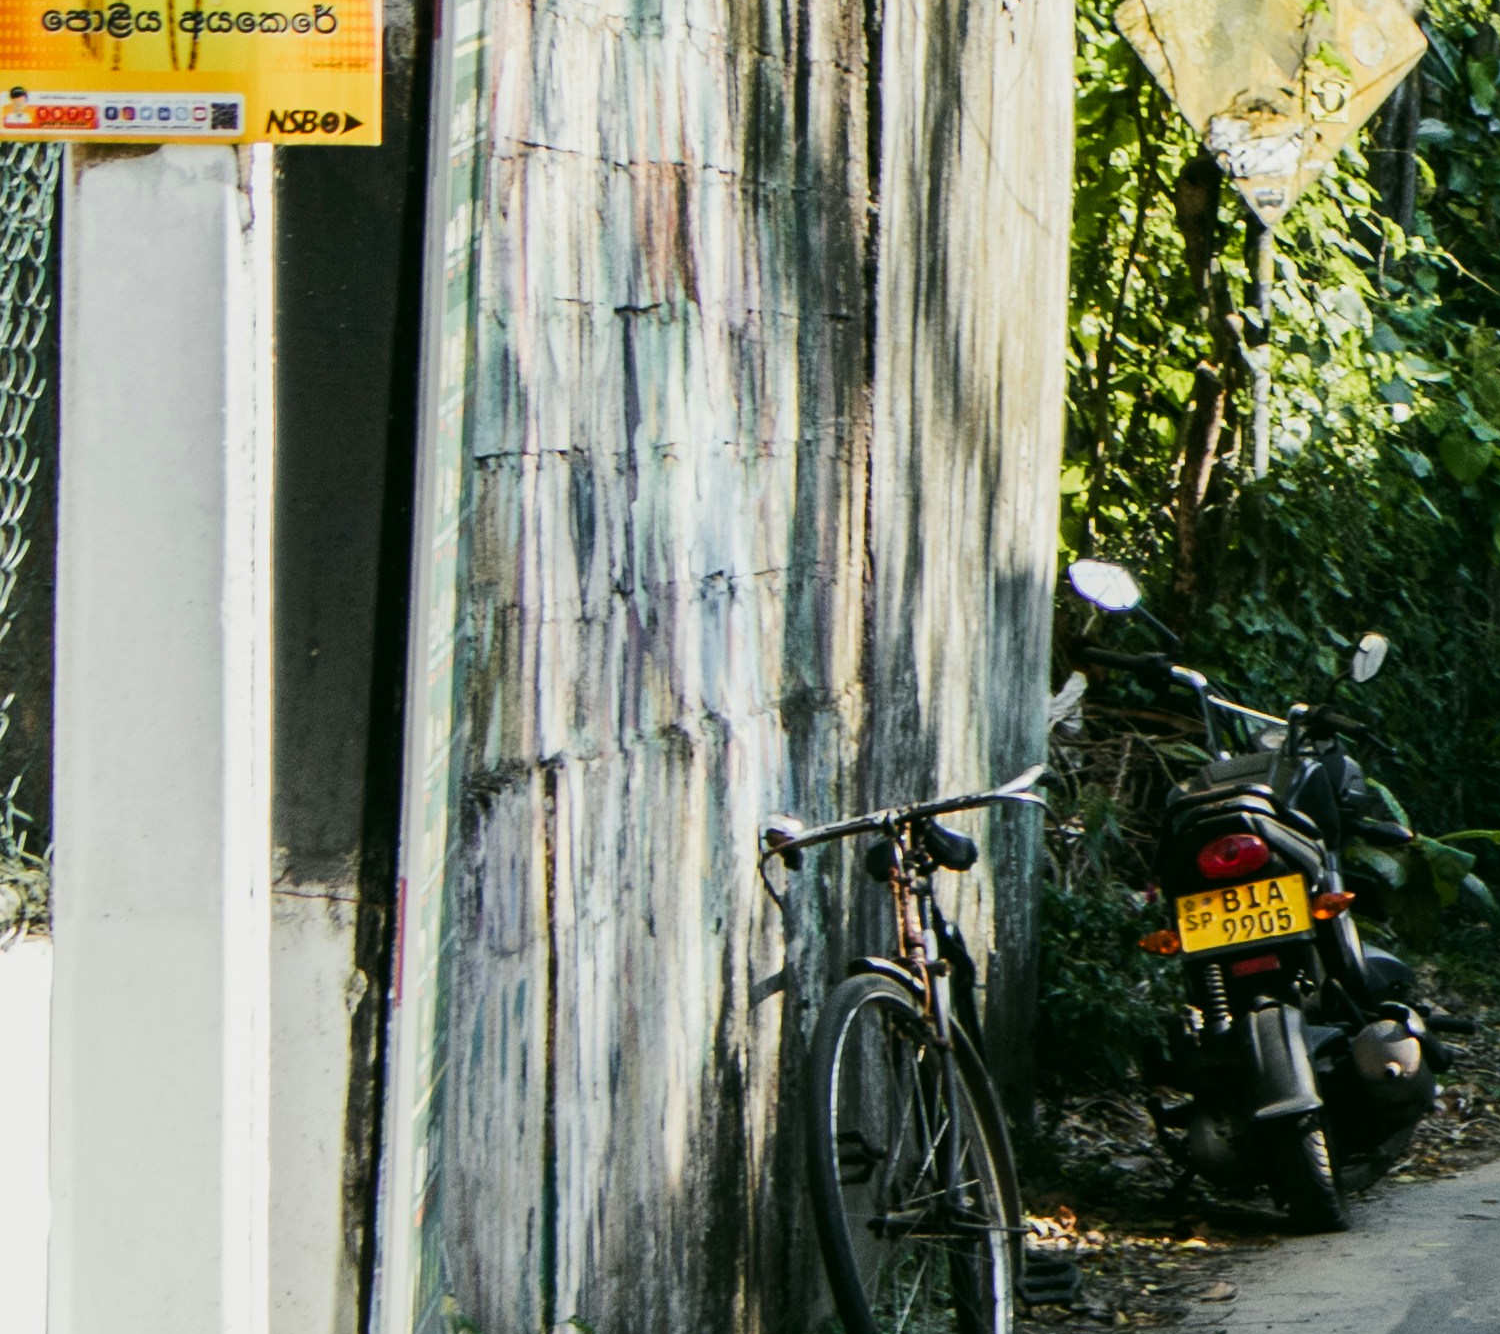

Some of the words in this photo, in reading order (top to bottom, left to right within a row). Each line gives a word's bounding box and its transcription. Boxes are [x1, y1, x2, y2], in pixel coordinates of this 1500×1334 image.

[266, 109, 320, 135] NSB
[1222, 880, 1285, 913] BIA
[1186, 911, 1213, 931] SP
[1222, 907, 1293, 942] 9905
